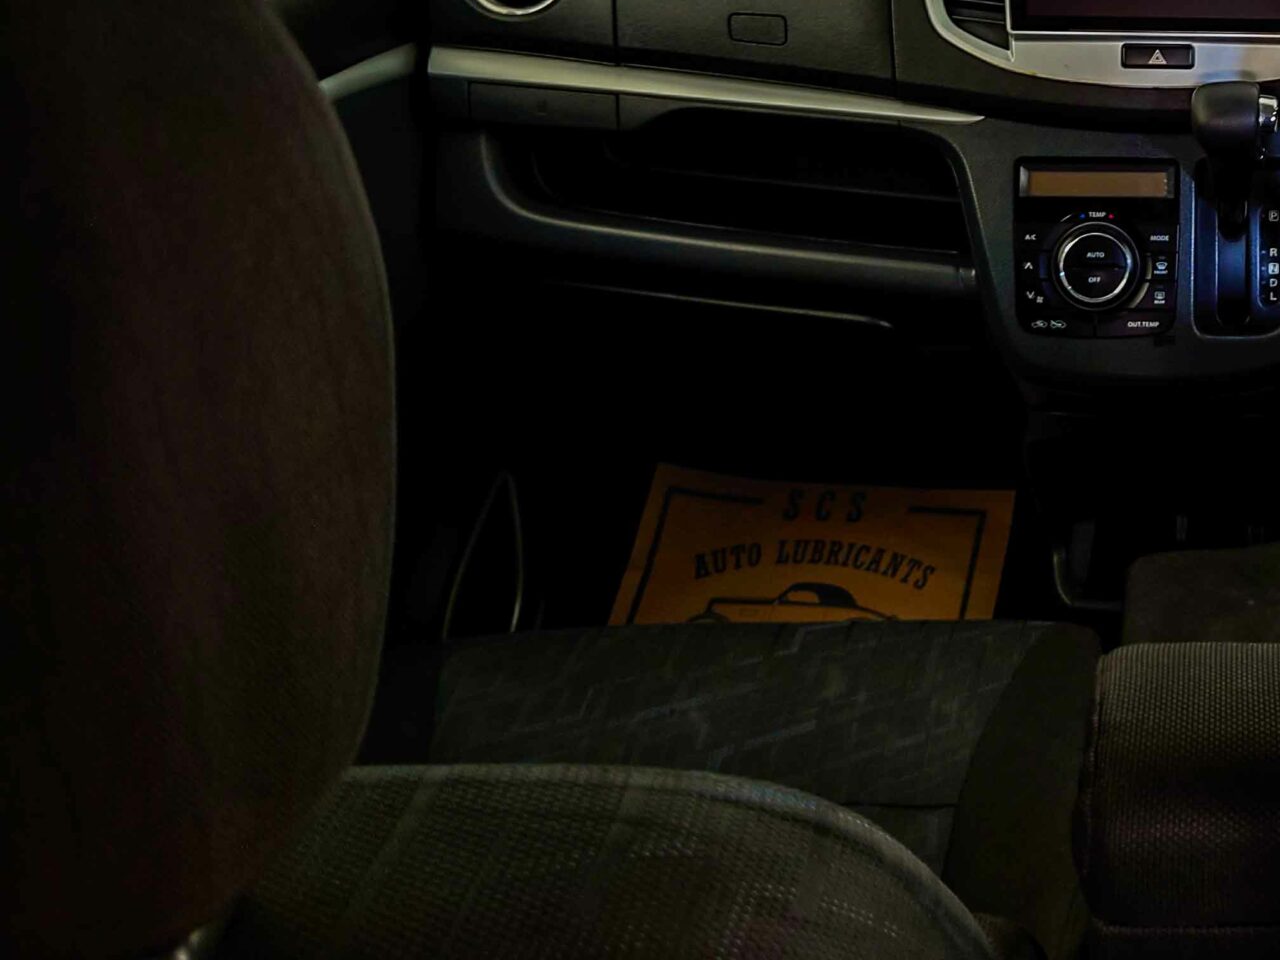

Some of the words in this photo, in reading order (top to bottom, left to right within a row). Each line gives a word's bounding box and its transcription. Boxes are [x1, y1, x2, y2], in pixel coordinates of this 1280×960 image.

[1086, 251, 1105, 259] AUTO
[1269, 247, 1278, 257] R
[1088, 276, 1101, 284] OFF
[1269, 278, 1278, 288] D
[1269, 292, 1277, 301] L
[693, 543, 762, 581] AUTO
[775, 538, 936, 590] LUBRICANTS
